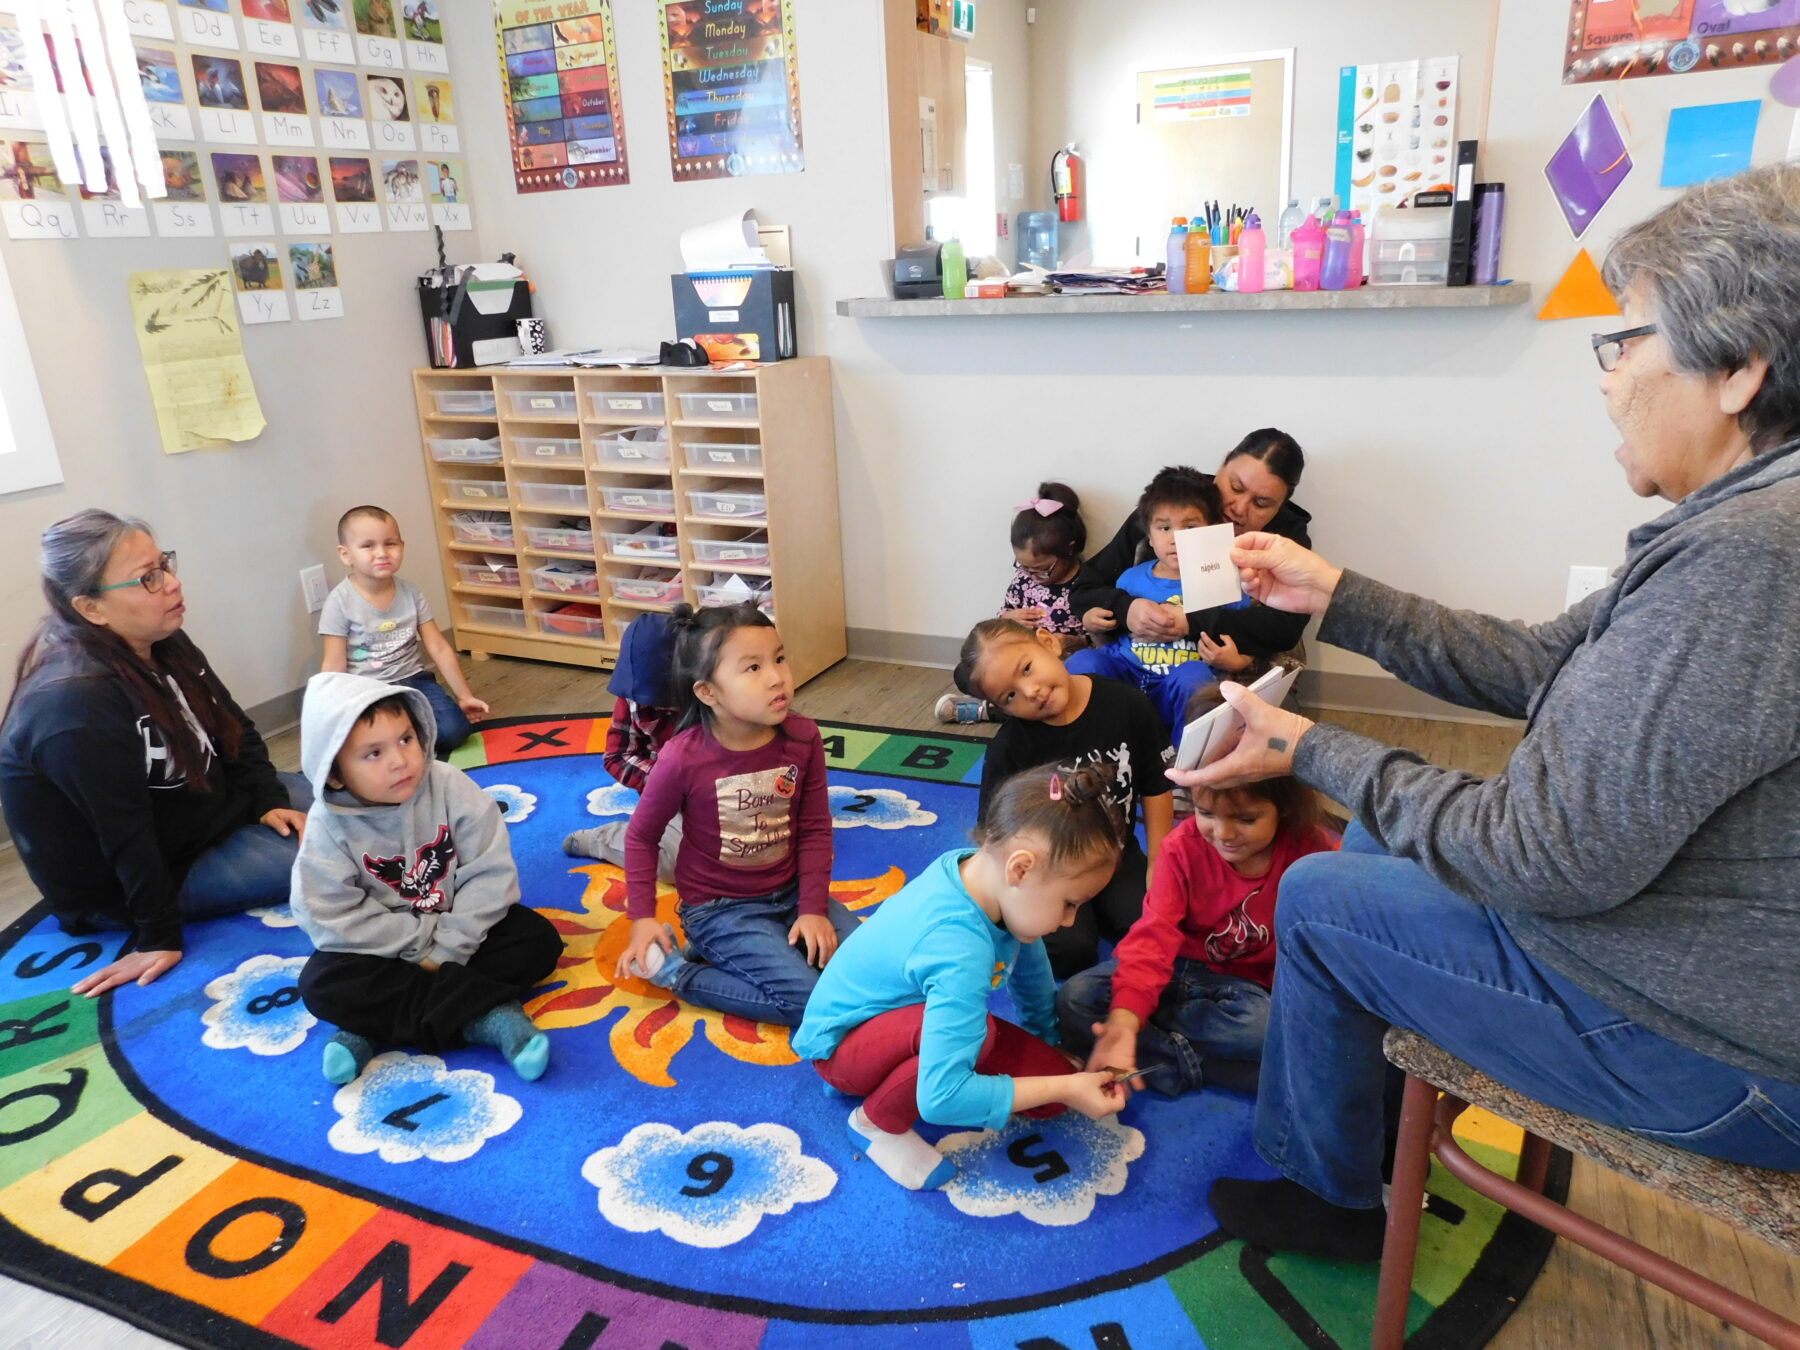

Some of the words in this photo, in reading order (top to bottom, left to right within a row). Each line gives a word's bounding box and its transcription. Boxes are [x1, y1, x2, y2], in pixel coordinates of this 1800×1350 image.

[515, 10, 529, 24] OF
[533, 6, 554, 22] THE
[557, 2, 589, 17] YEAR
[704, 0, 743, 15] Sunday
[191, 11, 222, 37] Dd
[257, 22, 283, 46] Ee
[705, 21, 746, 39] Monday
[1697, 20, 1731, 34] Oval
[317, 32, 340, 53] Ff
[1586, 32, 1634, 45] Square
[367, 38, 393, 67] Gg
[417, 46, 437, 63] Hh
[705, 43, 749, 59] Tuesday
[699, 66, 759, 83] Wednesday
[582, 98, 605, 107] October
[216, 113, 237, 133] Ll
[273, 116, 303, 137] Mm
[332, 120, 356, 140] Nn
[382, 124, 405, 142] Oo
[430, 126, 448, 151] Pp
[585, 144, 612, 155] December
[21, 204, 72, 237] Qq
[103, 204, 129, 226] Rr
[171, 205, 196, 227] Ss
[233, 206, 259, 226] Tt
[293, 206, 316, 226] Uu
[345, 205, 371, 224] Vv
[389, 205, 426, 223] Ww
[442, 205, 460, 223] Xx
[253, 295, 274, 320] Yy
[310, 291, 330, 310] Zz
[514, 727, 571, 752] X
[823, 735, 845, 758] A
[900, 745, 954, 769] B
[735, 788, 774, 811] Born
[841, 795, 876, 812] 2
[747, 812, 768, 832] To
[729, 828, 787, 858] Sparkle
[14, 942, 102, 979] S
[247, 987, 302, 1015] 8
[0, 1000, 70, 1049] R
[0, 1067, 88, 1146] Q
[382, 1093, 451, 1132] 7
[1007, 1134, 1069, 1182] 5
[679, 1152, 733, 1198] 6
[60, 1155, 184, 1222] P
[185, 1197, 306, 1279] O
[316, 1241, 472, 1348] N
